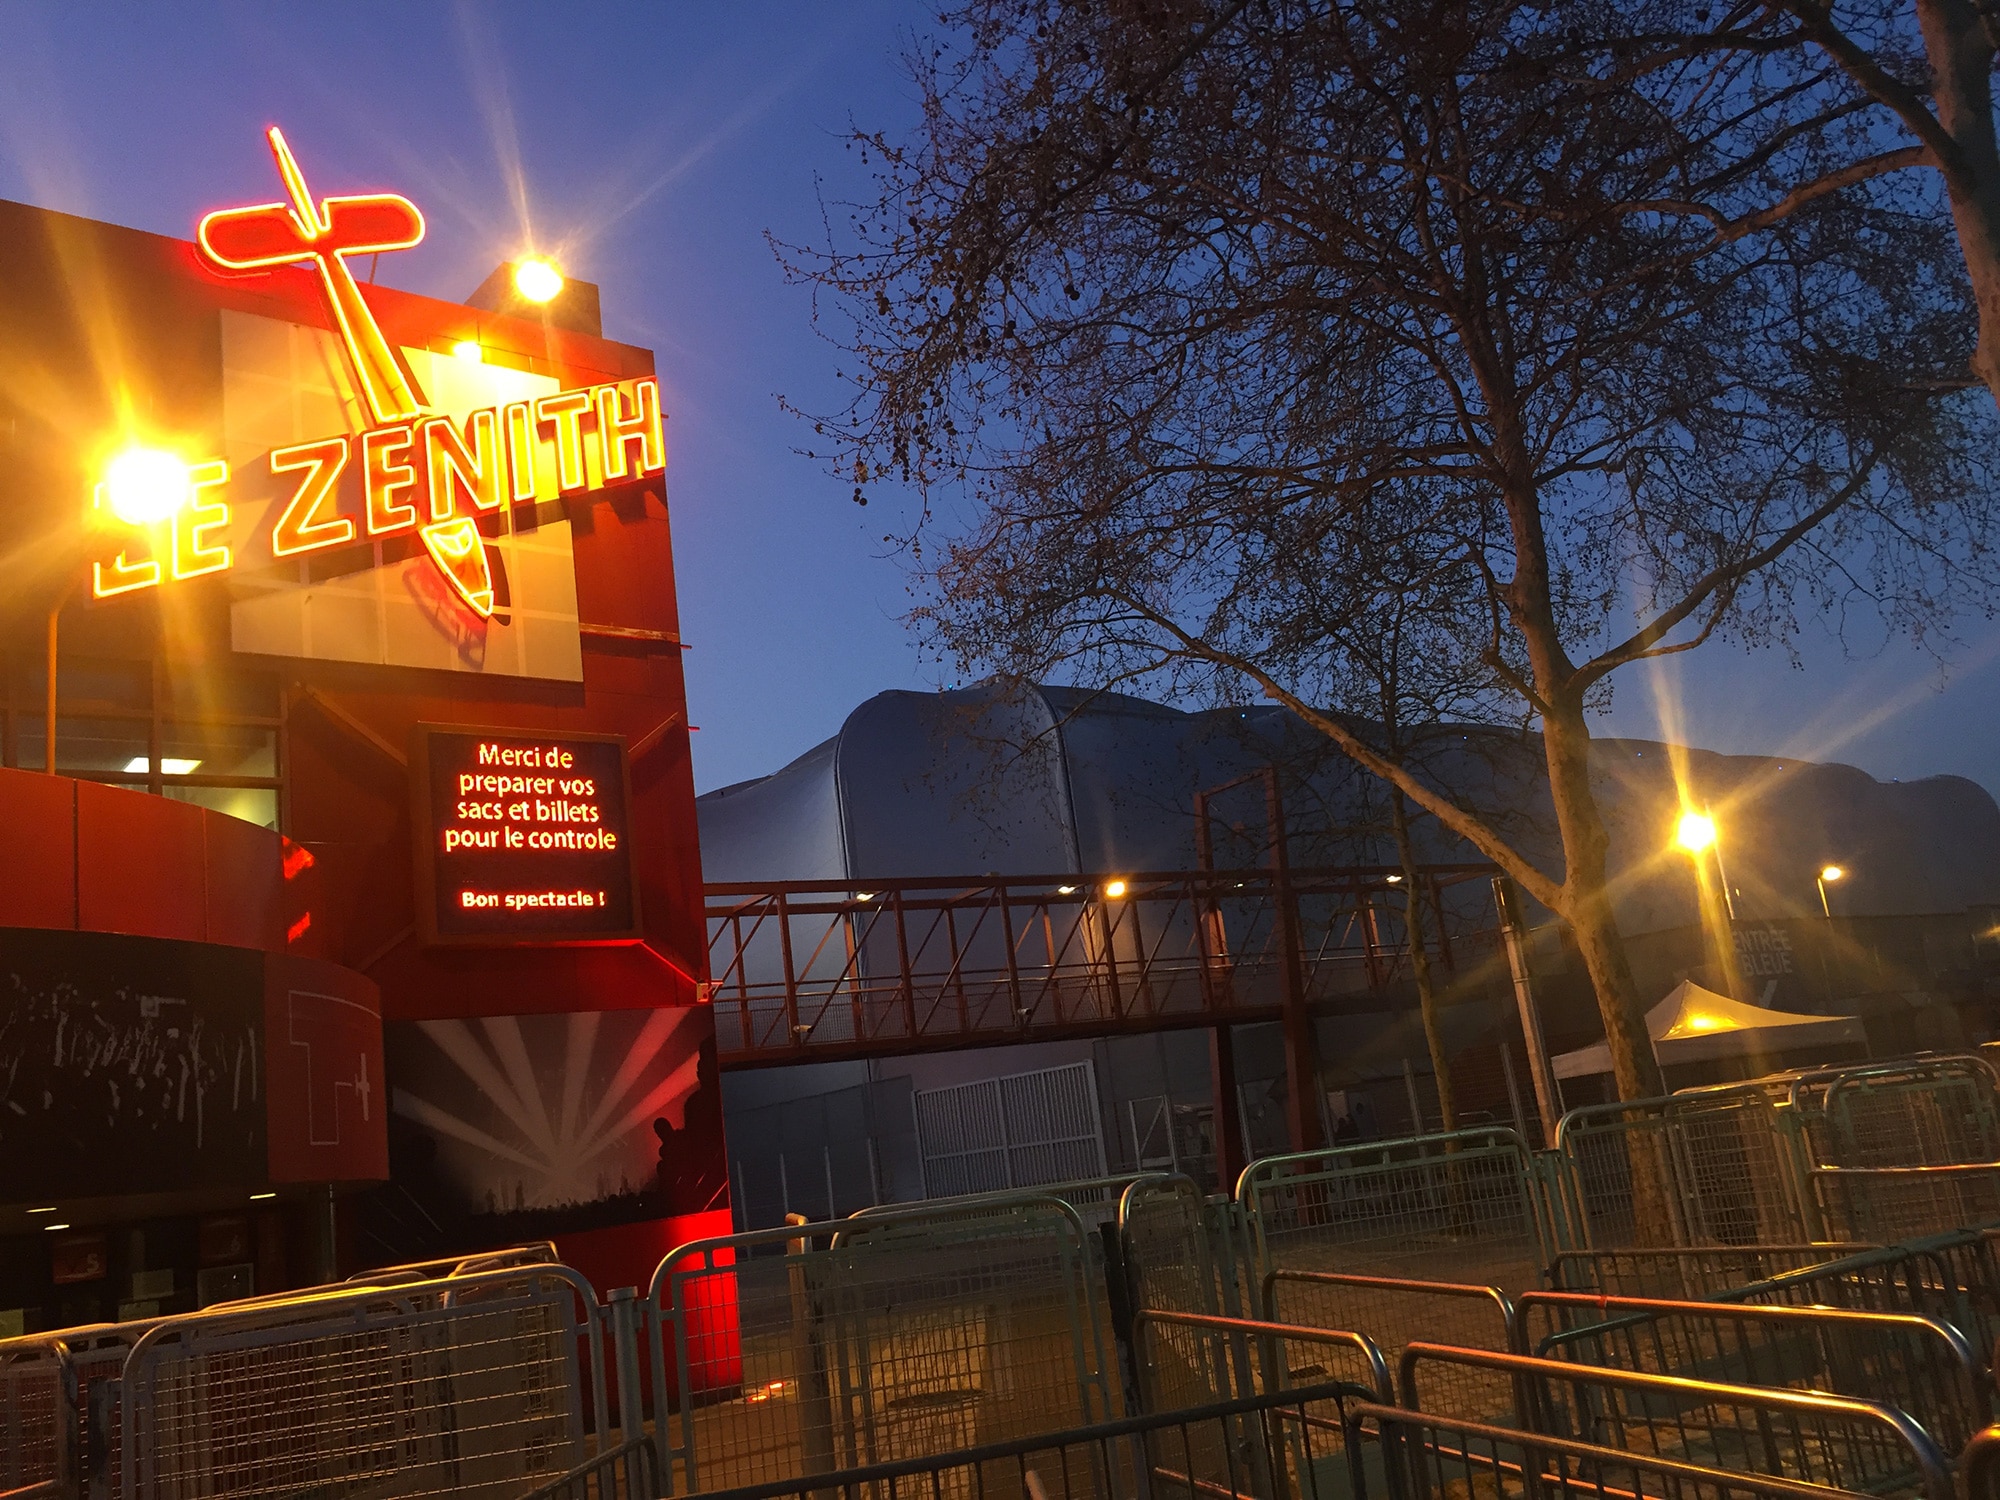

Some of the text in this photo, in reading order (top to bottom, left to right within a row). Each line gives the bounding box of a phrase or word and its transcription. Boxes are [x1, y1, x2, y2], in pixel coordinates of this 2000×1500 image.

[271, 377, 666, 557] ZENITH
[479, 744, 574, 769] Merci de
[459, 773, 595, 797] preparer vos
[457, 799, 600, 823] sacs et billets
[445, 825, 617, 852] pour le controle
[462, 891, 499, 907] Bon
[505, 890, 594, 911] spectacle
[1741, 952, 1793, 975] BLEUE
